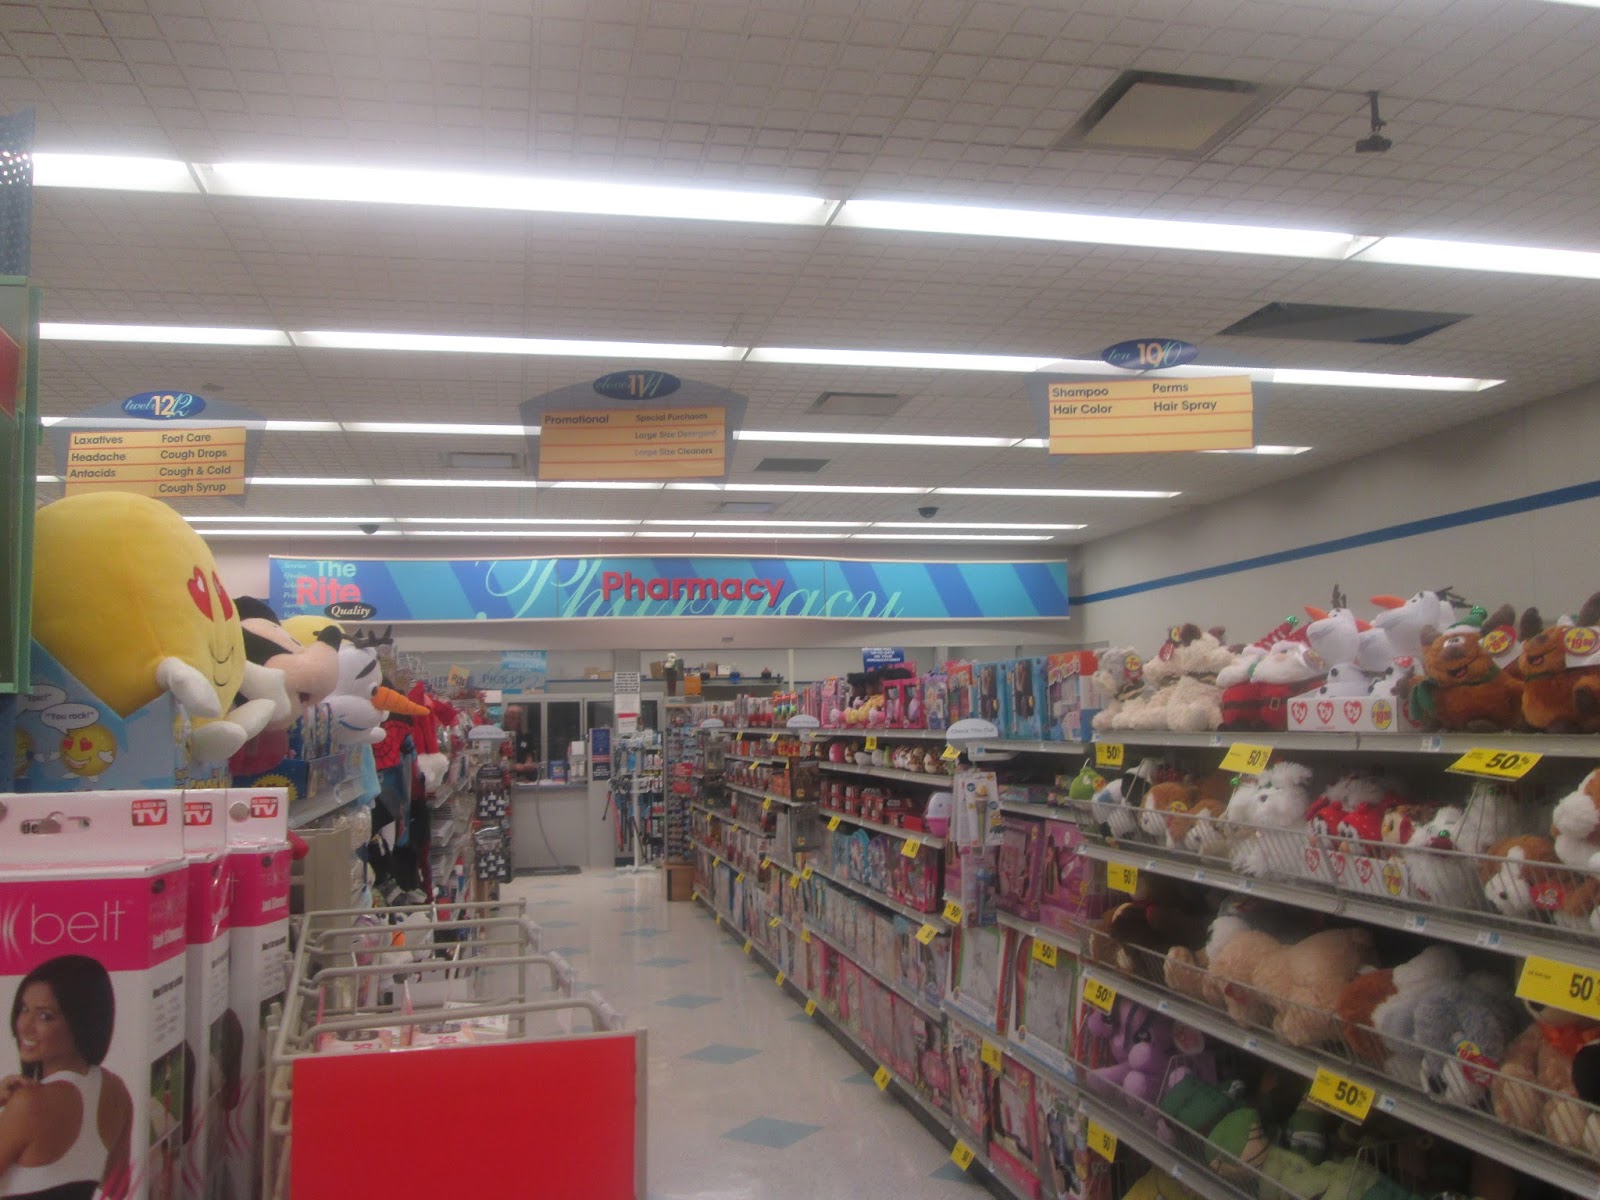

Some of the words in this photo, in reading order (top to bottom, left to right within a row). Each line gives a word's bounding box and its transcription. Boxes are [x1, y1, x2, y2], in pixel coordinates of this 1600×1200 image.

[1137, 342, 1164, 365] 10
[628, 374, 645, 397] 11
[1152, 383, 1189, 393] Perms
[1052, 387, 1109, 398] Shampoo
[152, 394, 175, 416] 12
[1053, 405, 1077, 415] Hair
[1081, 404, 1113, 414] Color
[1153, 401, 1178, 411] Hair
[1181, 400, 1217, 412] Spray
[544, 414, 609, 425] Promotional
[635, 413, 666, 423] Special
[667, 412, 708, 422] Purchases
[74, 435, 123, 445] Laxatives
[161, 434, 184, 444] Foot
[186, 432, 212, 443] Care
[635, 431, 657, 440] Large
[659, 430, 676, 439] Size
[677, 429, 717, 440] Detergent
[71, 452, 126, 462] Headache
[160, 449, 195, 461] Cough
[197, 448, 228, 460] Drops
[635, 448, 657, 457] Large
[659, 447, 676, 456] Size
[677, 446, 713, 455] Cleaners
[69, 468, 116, 479] Antacids
[159, 467, 194, 478] Cough
[196, 466, 204, 476] &
[206, 465, 231, 476] Cold
[158, 484, 194, 495] Cough
[196, 482, 226, 494] Syrup
[316, 560, 357, 578] The
[296, 576, 362, 606] Rite
[602, 571, 785, 607] Pharmacy
[330, 605, 371, 619] Quality
[133, 808, 166, 824] TV
[251, 804, 276, 816] TV
[184, 810, 211, 823] TV
[31, 900, 126, 945] belt
